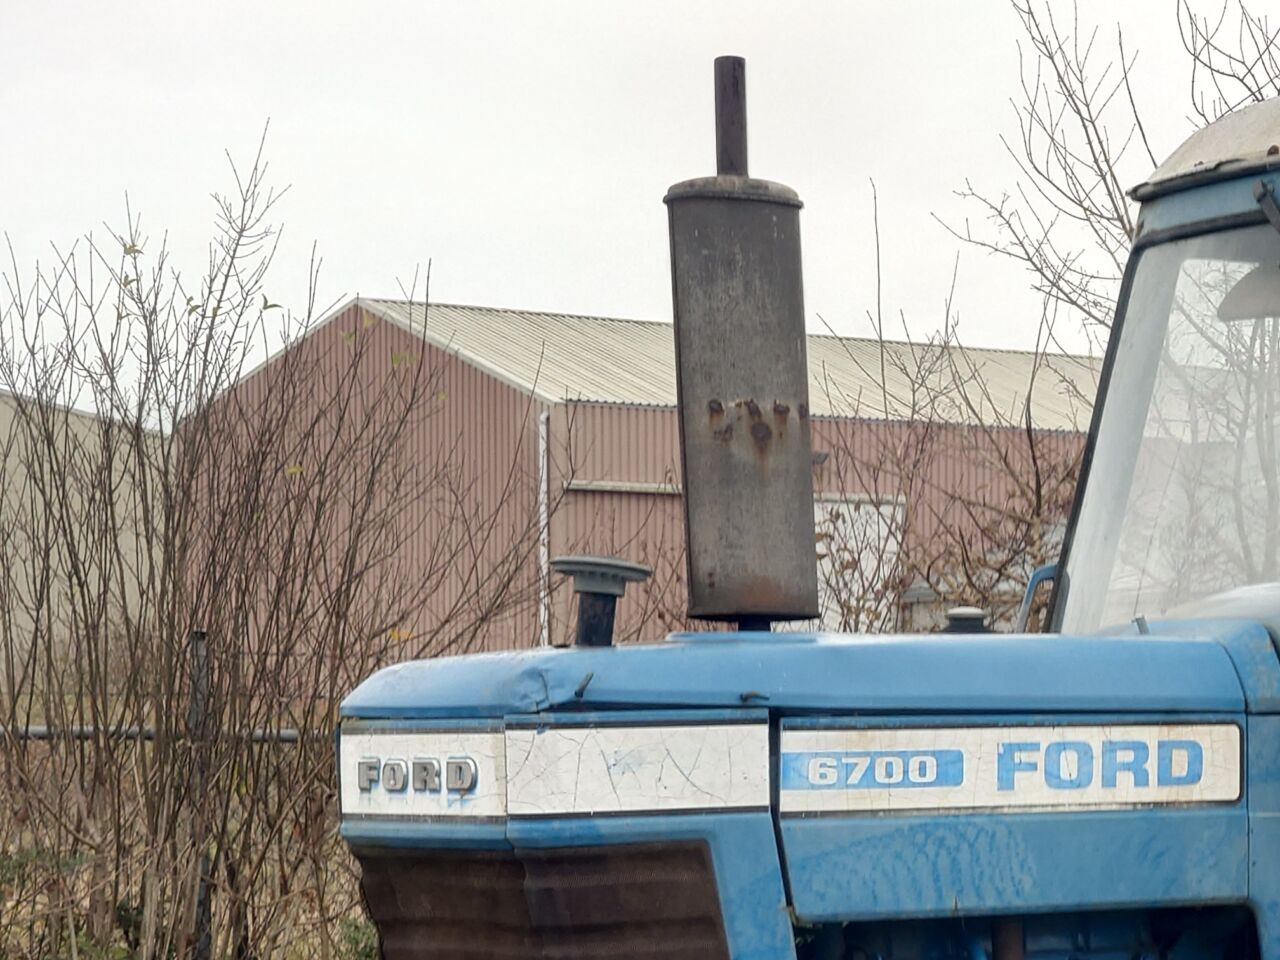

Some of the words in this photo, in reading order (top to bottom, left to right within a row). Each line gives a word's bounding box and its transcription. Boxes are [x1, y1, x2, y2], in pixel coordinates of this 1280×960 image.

[357, 756, 479, 793] FORD
[808, 755, 938, 785] 6700
[996, 739, 1205, 792] FORD
